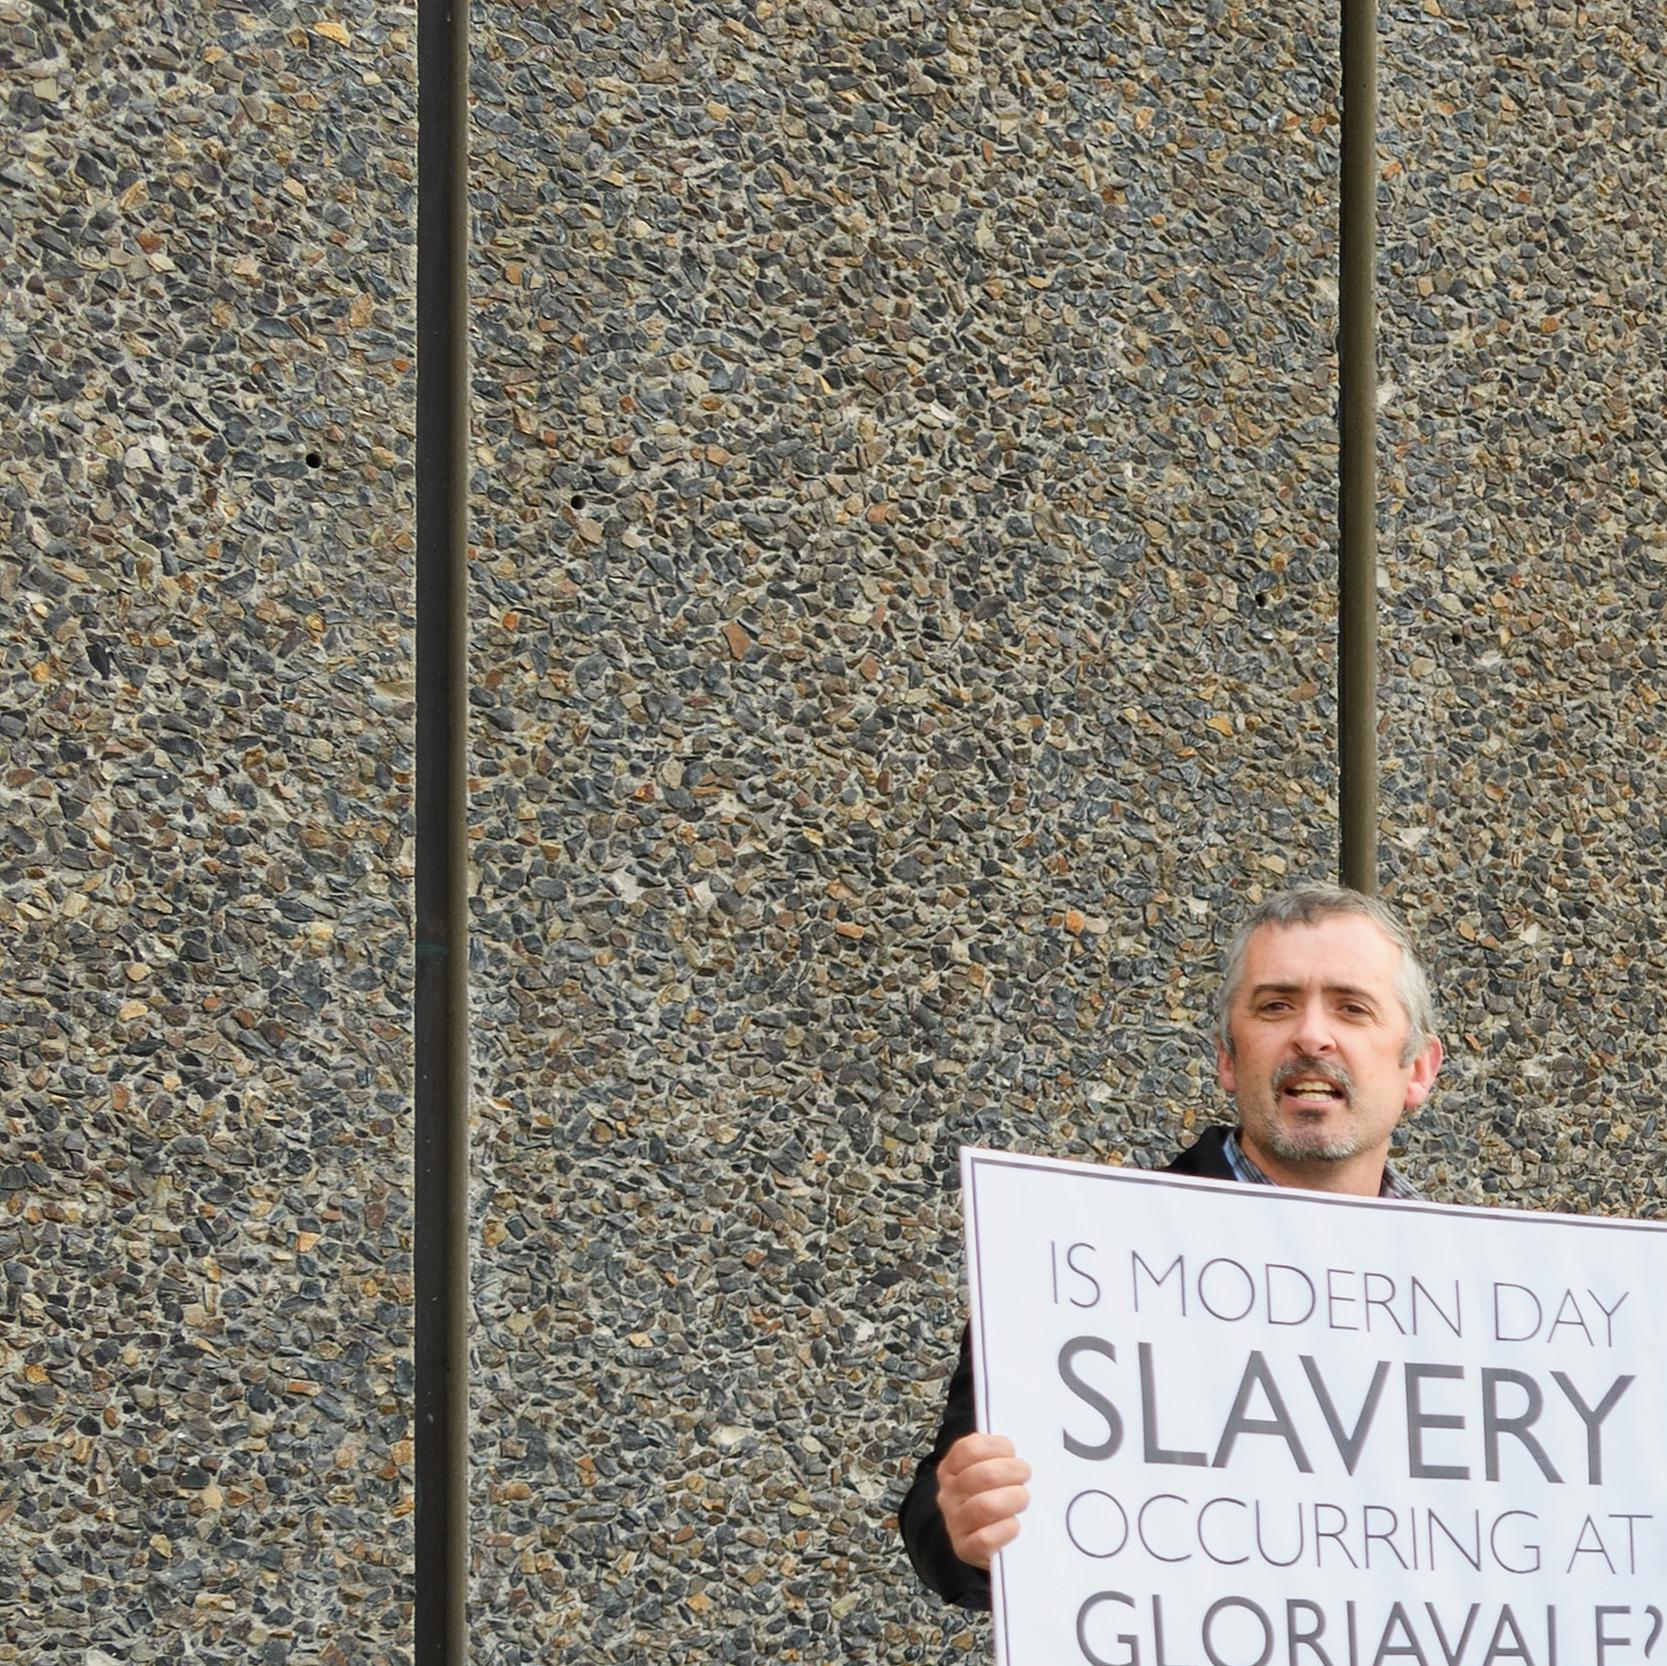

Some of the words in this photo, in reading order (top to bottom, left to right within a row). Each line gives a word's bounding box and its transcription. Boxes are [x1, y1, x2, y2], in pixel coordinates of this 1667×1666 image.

[1051, 1241, 1101, 1309] IS
[1131, 1249, 1462, 1339] MODERN
[1494, 1282, 1630, 1348] DAY
[1057, 1336, 1636, 1486] SLAVERY
[1065, 1489, 1542, 1575] OCCURRING
[1566, 1514, 1653, 1575] AT
